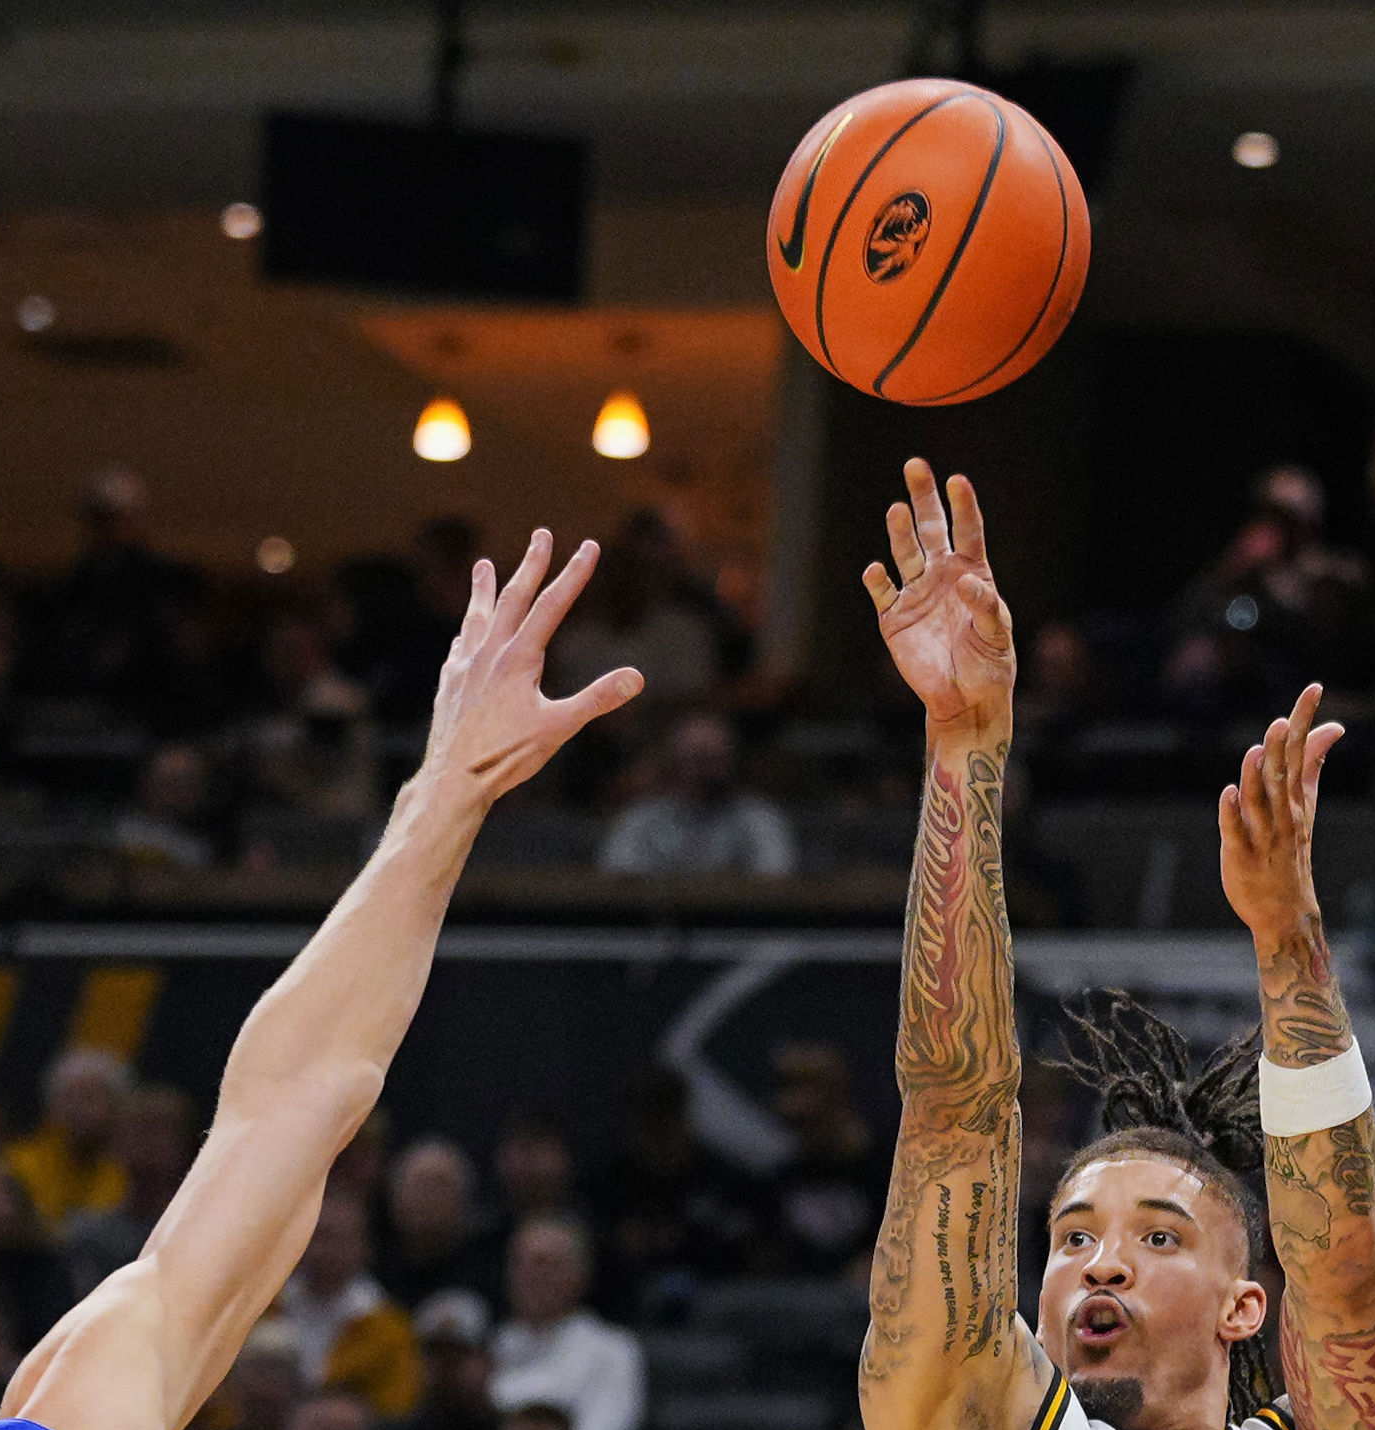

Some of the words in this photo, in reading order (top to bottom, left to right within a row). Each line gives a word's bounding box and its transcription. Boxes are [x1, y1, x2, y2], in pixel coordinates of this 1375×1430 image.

[936, 1183, 952, 1231] person
[972, 1182, 988, 1209] love
[965, 1210, 981, 1232] you
[932, 1231, 948, 1258] you
[968, 1235, 979, 1262] and
[939, 1260, 952, 1285] are
[967, 1302, 979, 1322] you
